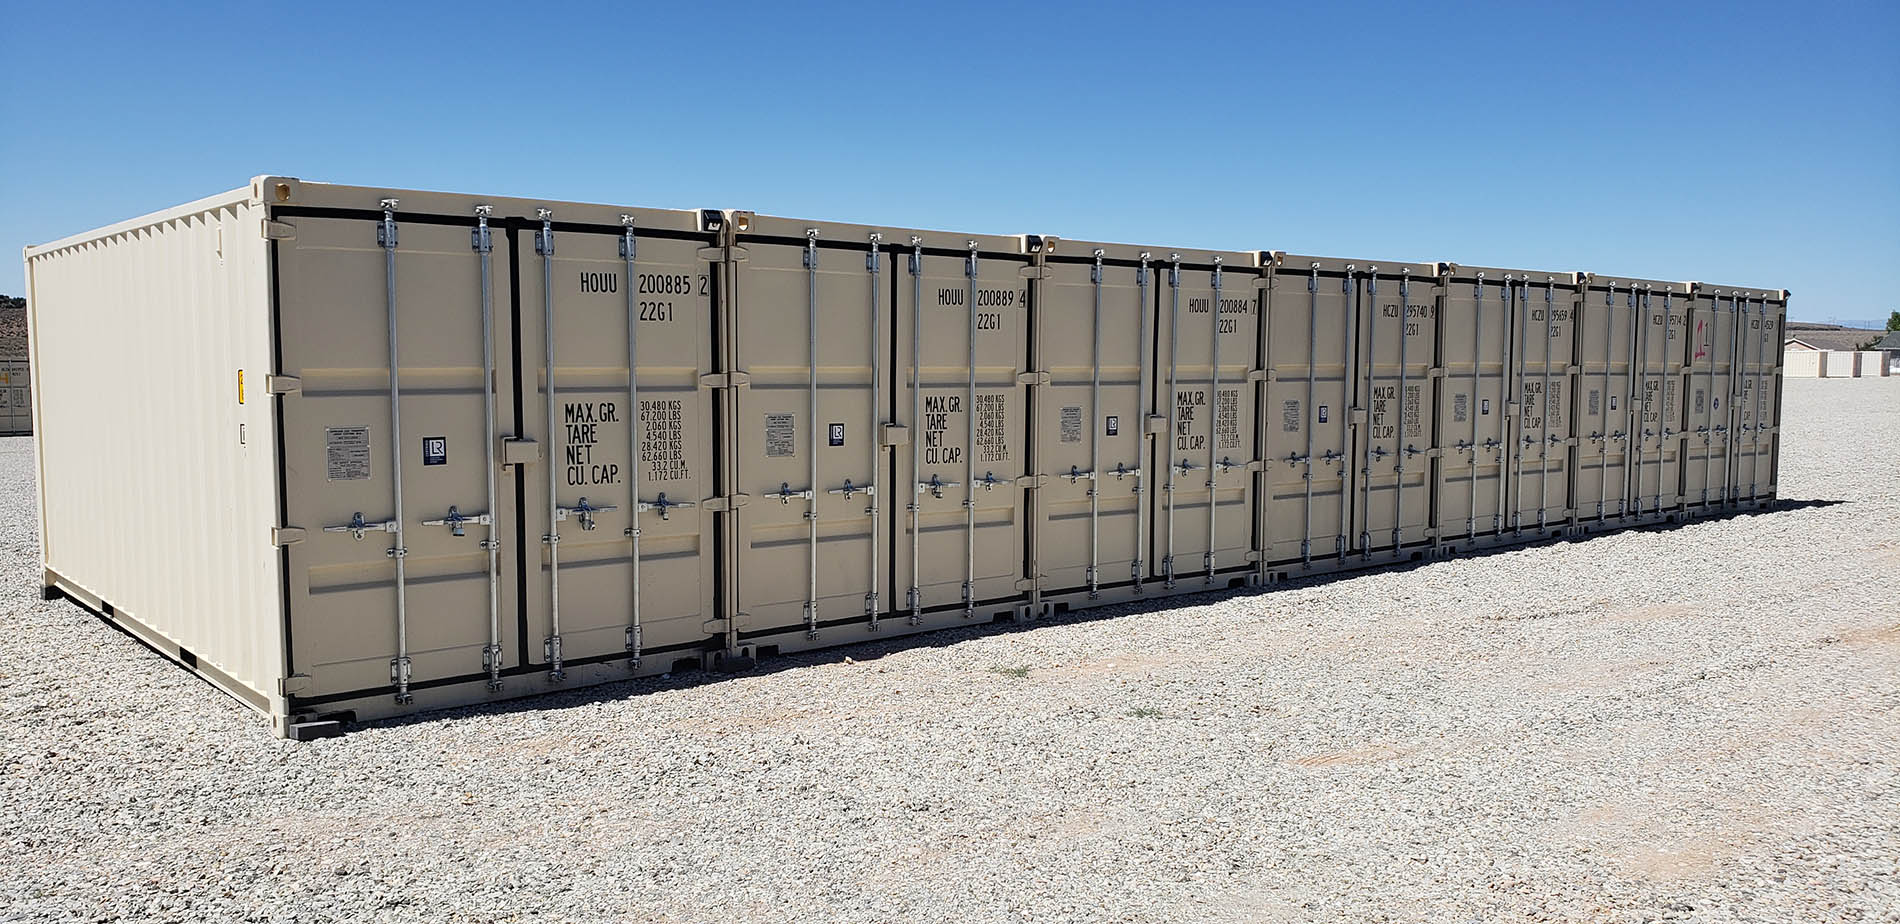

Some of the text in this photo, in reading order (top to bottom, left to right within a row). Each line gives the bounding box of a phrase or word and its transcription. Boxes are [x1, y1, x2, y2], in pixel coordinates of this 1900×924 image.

[580, 272, 708, 295] HOUU 200885 2
[938, 288, 964, 306] HOUU
[978, 290, 1014, 306] 200889
[640, 302, 672, 321] 22G1
[1189, 298, 1256, 314] HOUU 200884 7
[1383, 304, 1398, 317] HCZU
[978, 314, 1000, 329] 22G1
[1219, 319, 1237, 333] 22G1
[640, 400, 681, 411] 30.480 KGS
[641, 411, 681, 421] 67.200 LBS
[1177, 406, 1194, 420] TARE
[1373, 413, 1384, 425] NET
[646, 421, 682, 431] 2.060 KGS
[926, 414, 947, 430] TARE
[1177, 421, 1191, 436] NET
[566, 424, 597, 444] TARE
[646, 431, 682, 441] 4.540 LBS
[926, 431, 943, 447] NET
[431, 441, 444, 455] LR
[642, 441, 682, 451] 28.420 KGS
[1178, 436, 1206, 450] CU. CAP.
[566, 445, 592, 465] NET
[642, 451, 682, 461] 62.660 LBS
[926, 448, 962, 464] CU. CAP.
[652, 461, 668, 471] 33.2
[568, 464, 621, 485] CU. CAP.
[648, 471, 668, 481] 1.172
